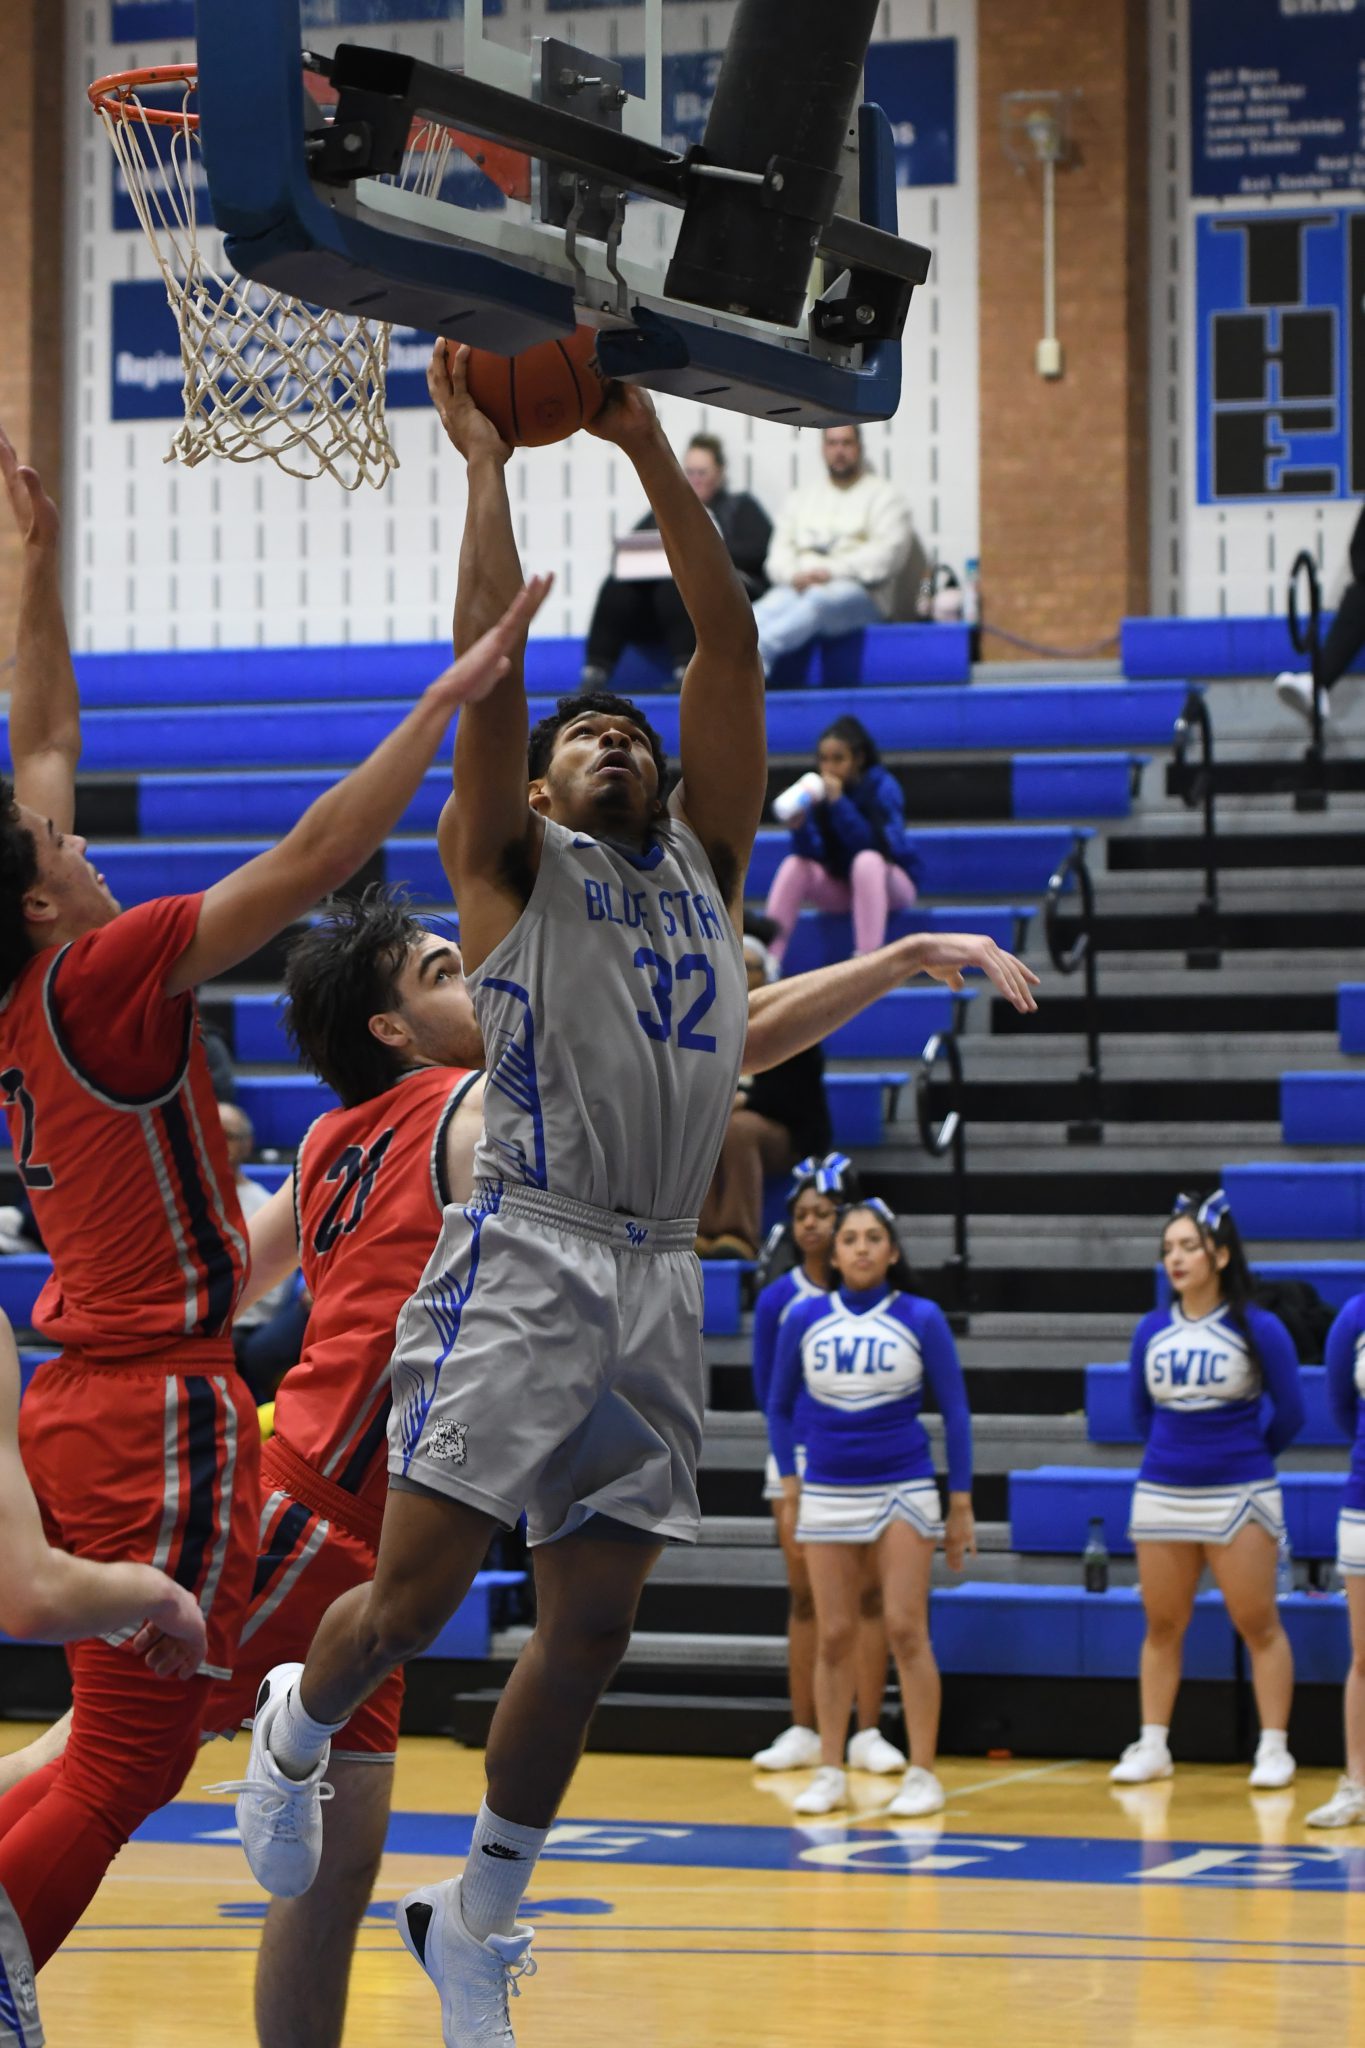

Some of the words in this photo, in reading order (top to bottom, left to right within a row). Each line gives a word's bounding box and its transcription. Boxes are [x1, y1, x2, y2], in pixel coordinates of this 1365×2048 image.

[585, 879, 652, 936] BLUE
[634, 946, 717, 1053] 32
[312, 1126, 394, 1257] 21
[813, 1336, 897, 1374] SWIC
[1153, 1349, 1229, 1387] SWIC
